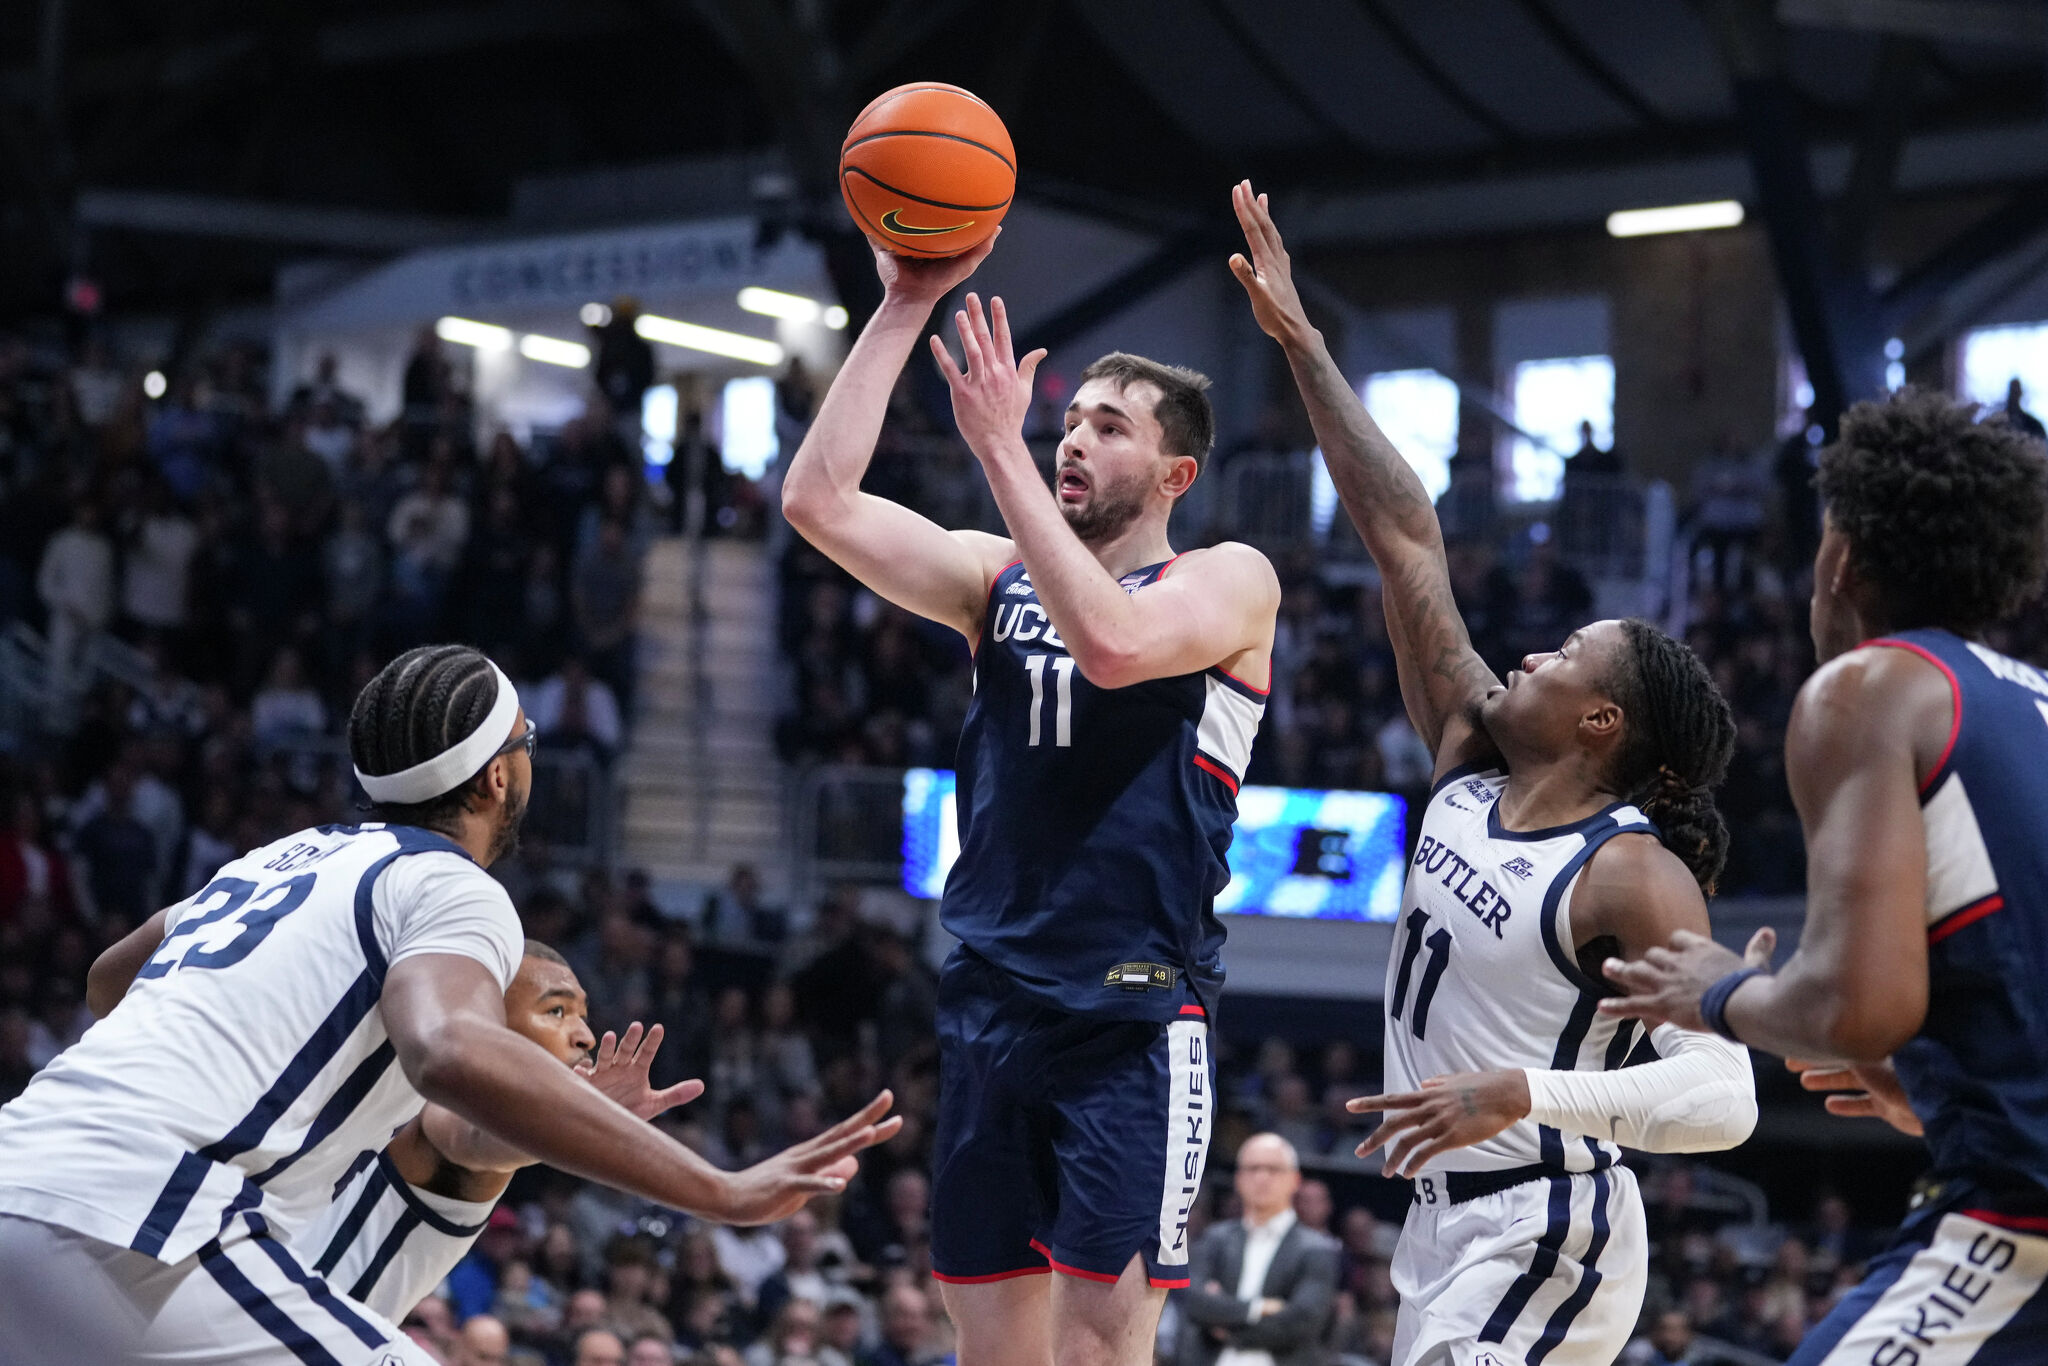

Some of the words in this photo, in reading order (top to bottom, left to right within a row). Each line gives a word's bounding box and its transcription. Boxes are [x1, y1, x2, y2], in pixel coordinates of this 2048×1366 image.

[1025, 655, 1075, 748] 11
[1414, 835, 1512, 940] BUTLER
[1504, 860, 1534, 878] EAST
[1513, 856, 1534, 869] BIG
[134, 872, 318, 979] 23
[1154, 969, 1166, 981] 48
[1391, 906, 1453, 1041] 11
